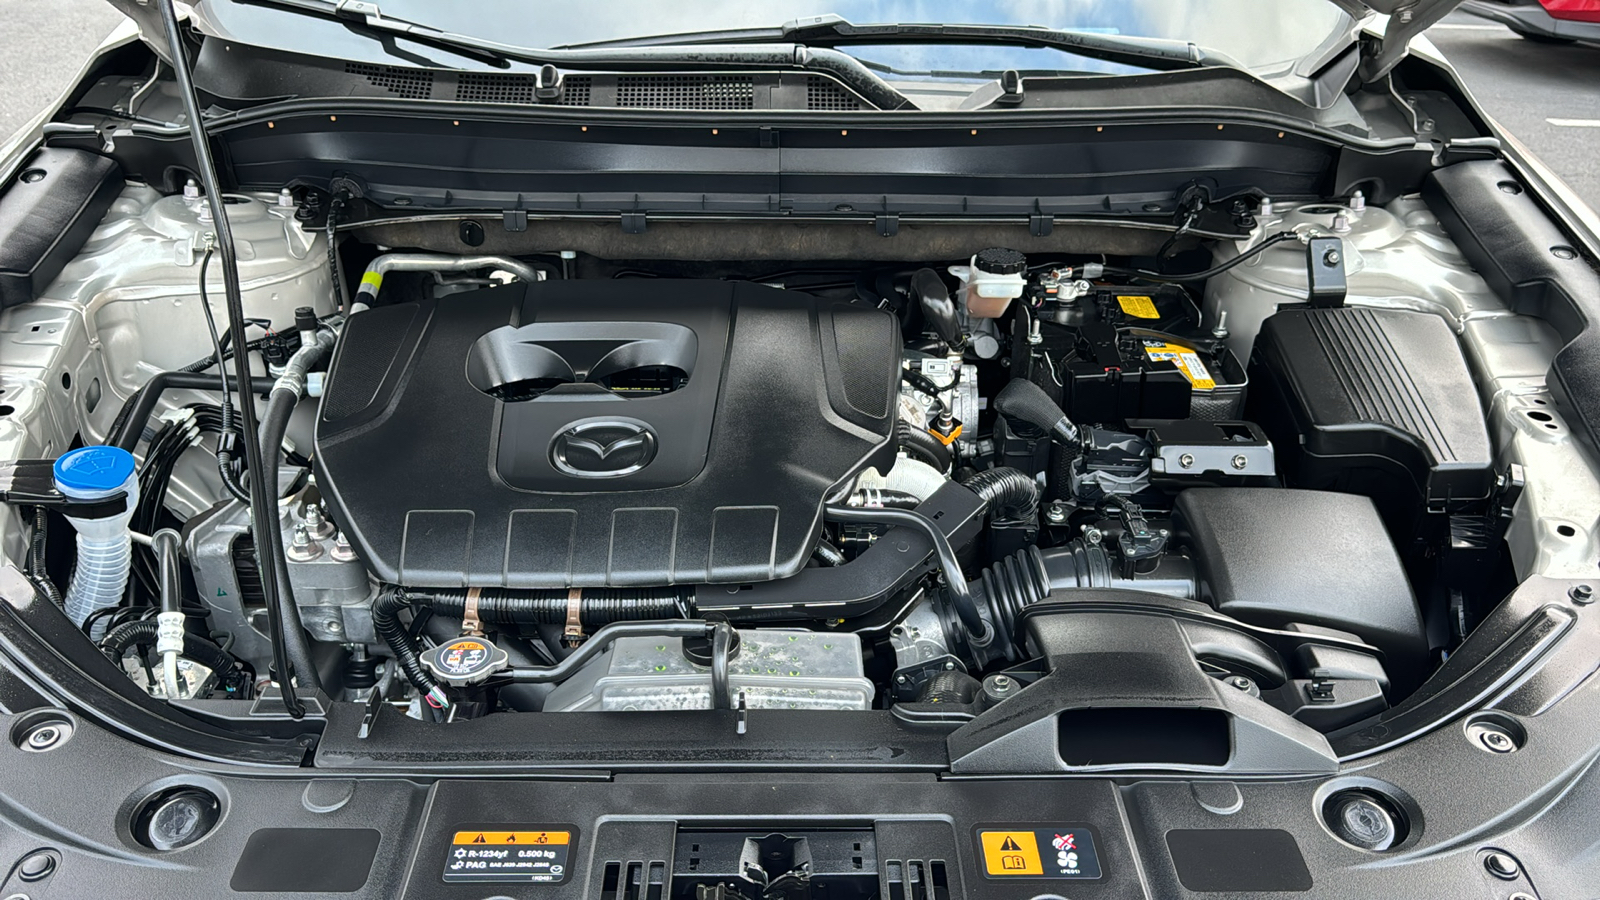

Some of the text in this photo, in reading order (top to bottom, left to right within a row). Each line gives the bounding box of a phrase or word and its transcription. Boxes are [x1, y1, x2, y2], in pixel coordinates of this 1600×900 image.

[468, 850, 555, 859] R-1234yf 0.500 kg
